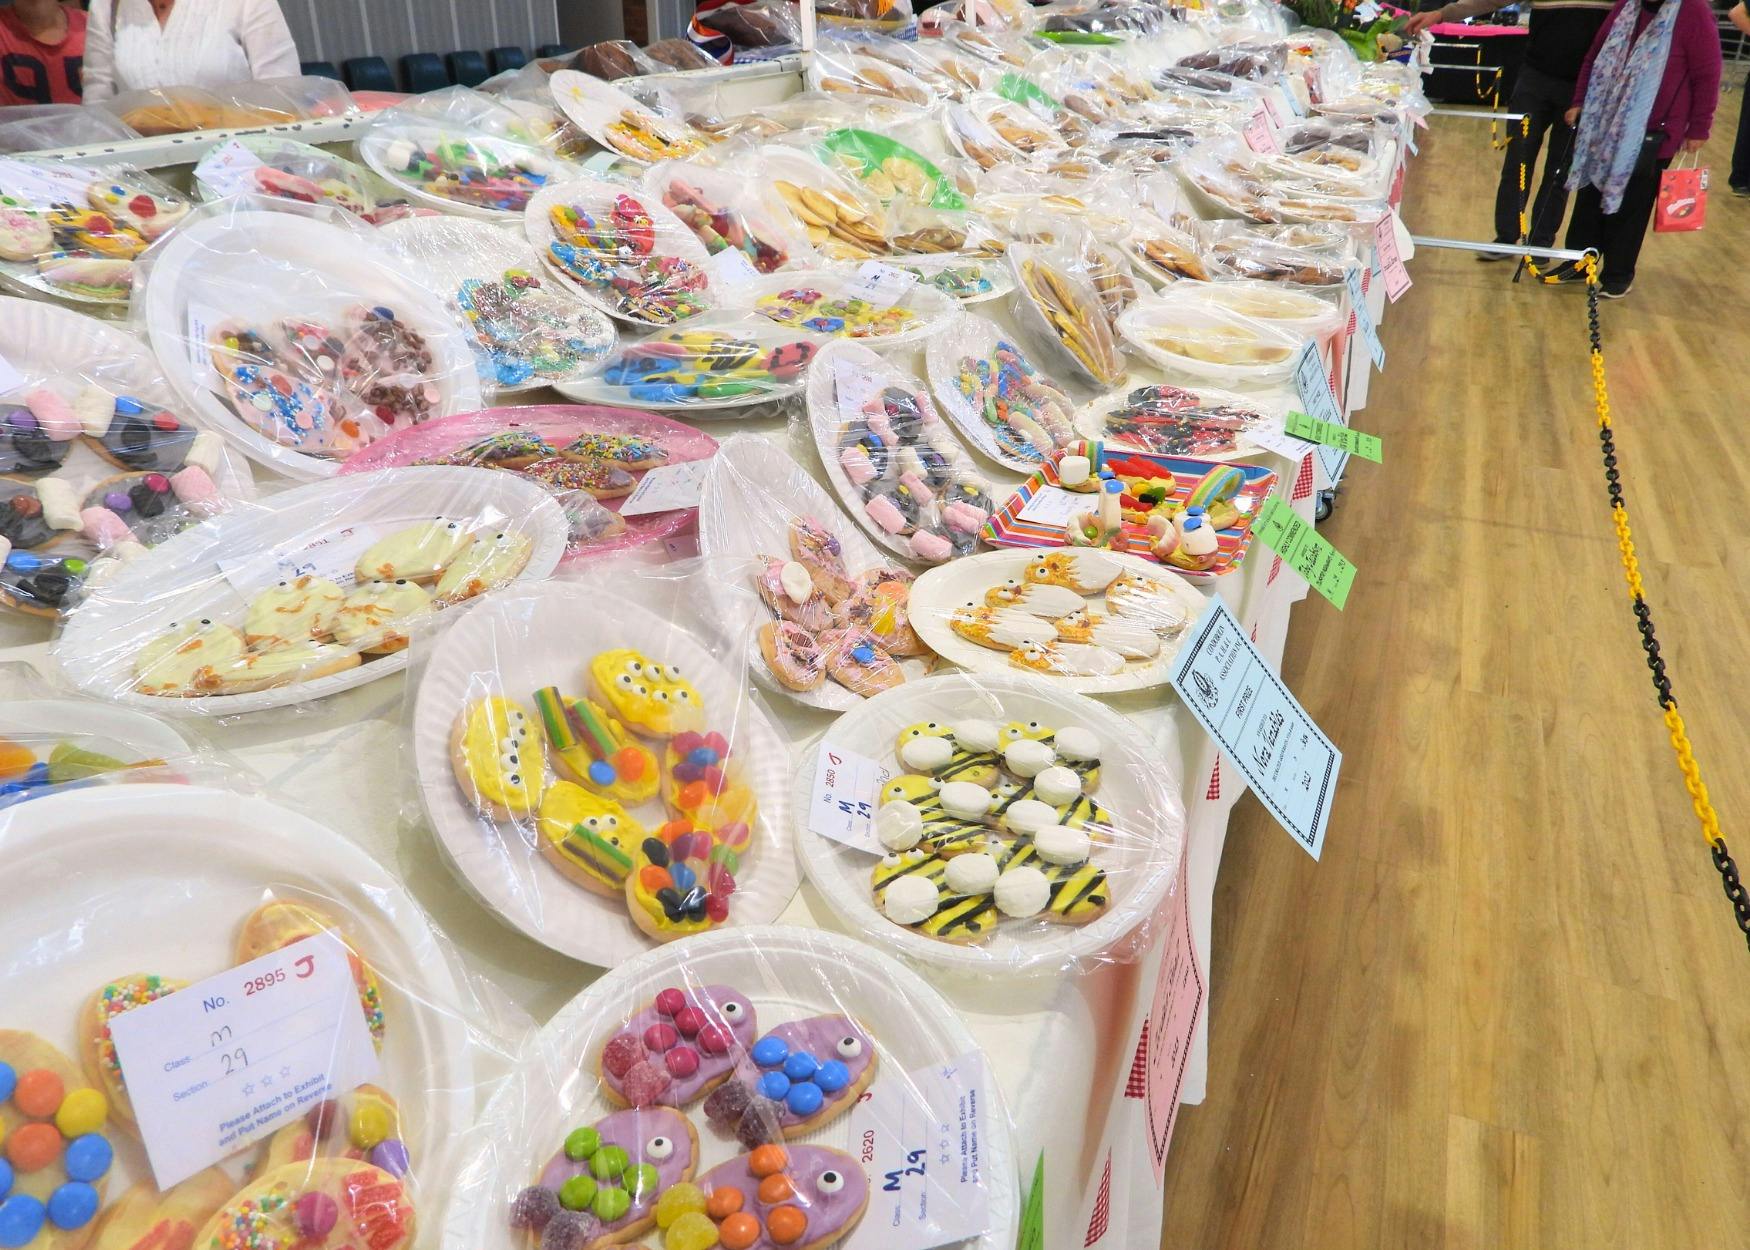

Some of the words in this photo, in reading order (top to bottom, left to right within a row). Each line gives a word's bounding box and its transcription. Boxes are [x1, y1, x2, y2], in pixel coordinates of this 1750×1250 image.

[1235, 700, 1246, 719] FIRST
[1242, 685, 1253, 704] PRIZE
[825, 769, 836, 788] 2850
[839, 800, 855, 815] M
[857, 801, 872, 819] 29
[203, 995, 230, 1013] No.
[244, 968, 286, 997] 2895
[221, 1047, 249, 1075] 29
[220, 1112, 251, 1131] Please
[253, 1095, 282, 1115] Attach
[283, 1090, 293, 1100] to
[294, 1074, 325, 1094] Exhibit
[219, 1131, 236, 1146] and
[238, 1123, 256, 1136] Put
[256, 1109, 282, 1126] Name
[284, 1102, 295, 1112] on
[862, 1130, 875, 1163] 2620
[960, 1131, 968, 1156] Attach
[970, 1131, 978, 1153] Name
[905, 1150, 926, 1176] 29
[883, 1169, 904, 1191] M
